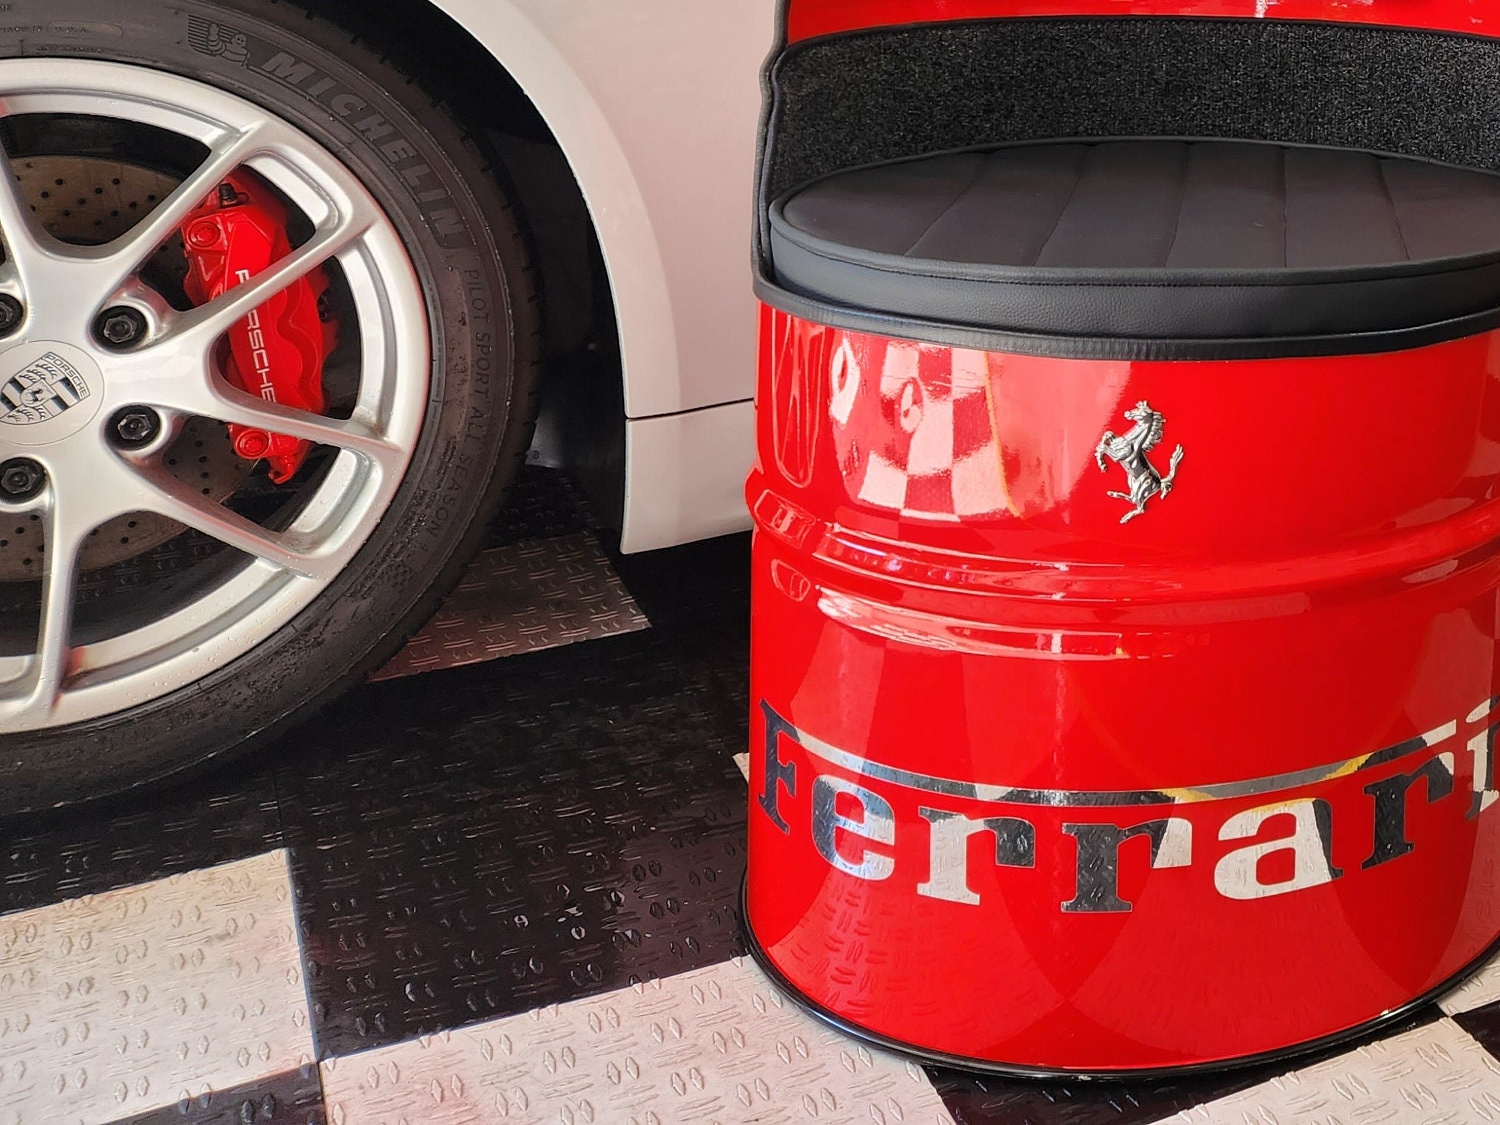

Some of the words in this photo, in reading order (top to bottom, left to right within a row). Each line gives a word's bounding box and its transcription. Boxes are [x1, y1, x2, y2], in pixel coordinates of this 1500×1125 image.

[261, 51, 465, 239] MICHELIN
[464, 269, 490, 324] PILOT
[235, 269, 277, 403] PRSCHE
[474, 332, 491, 399] SPORT
[44, 354, 88, 398] PORSCHE
